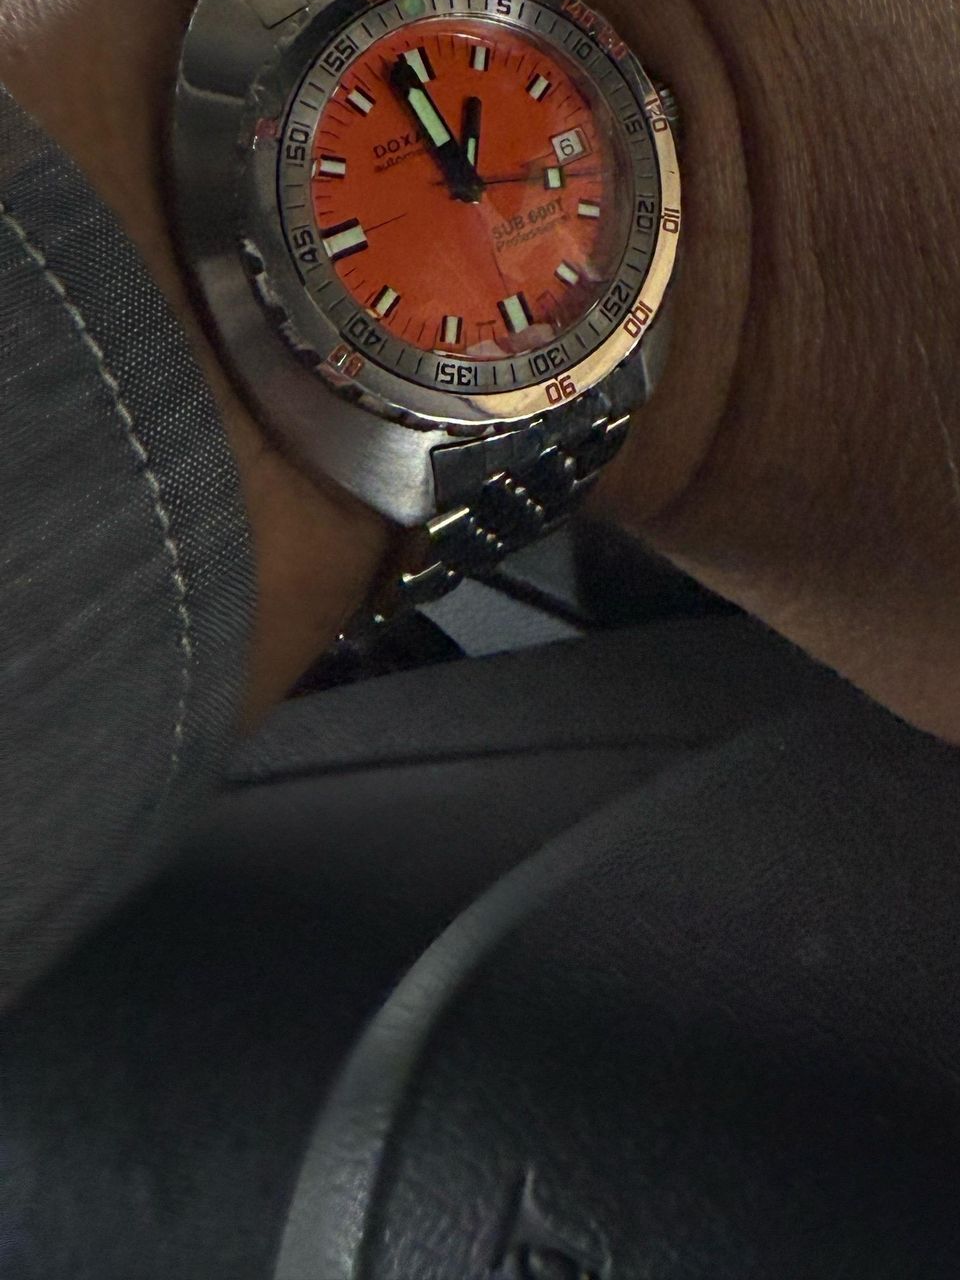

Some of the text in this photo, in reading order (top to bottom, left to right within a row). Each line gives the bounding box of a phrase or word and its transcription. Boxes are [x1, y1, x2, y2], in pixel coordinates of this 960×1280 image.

[324, 38, 356, 72] 55
[572, 37, 593, 60] 10
[286, 128, 310, 161] 50
[560, 137, 575, 157] 6
[492, 215, 526, 239] SUB
[637, 199, 655, 230] 20
[662, 207, 681, 234] 110
[293, 229, 320, 264] 45
[602, 284, 630, 317] 25
[350, 316, 382, 346] 40
[622, 300, 653, 339] 100
[440, 364, 473, 387] 35
[533, 347, 565, 376] 30
[545, 374, 577, 405] 90
